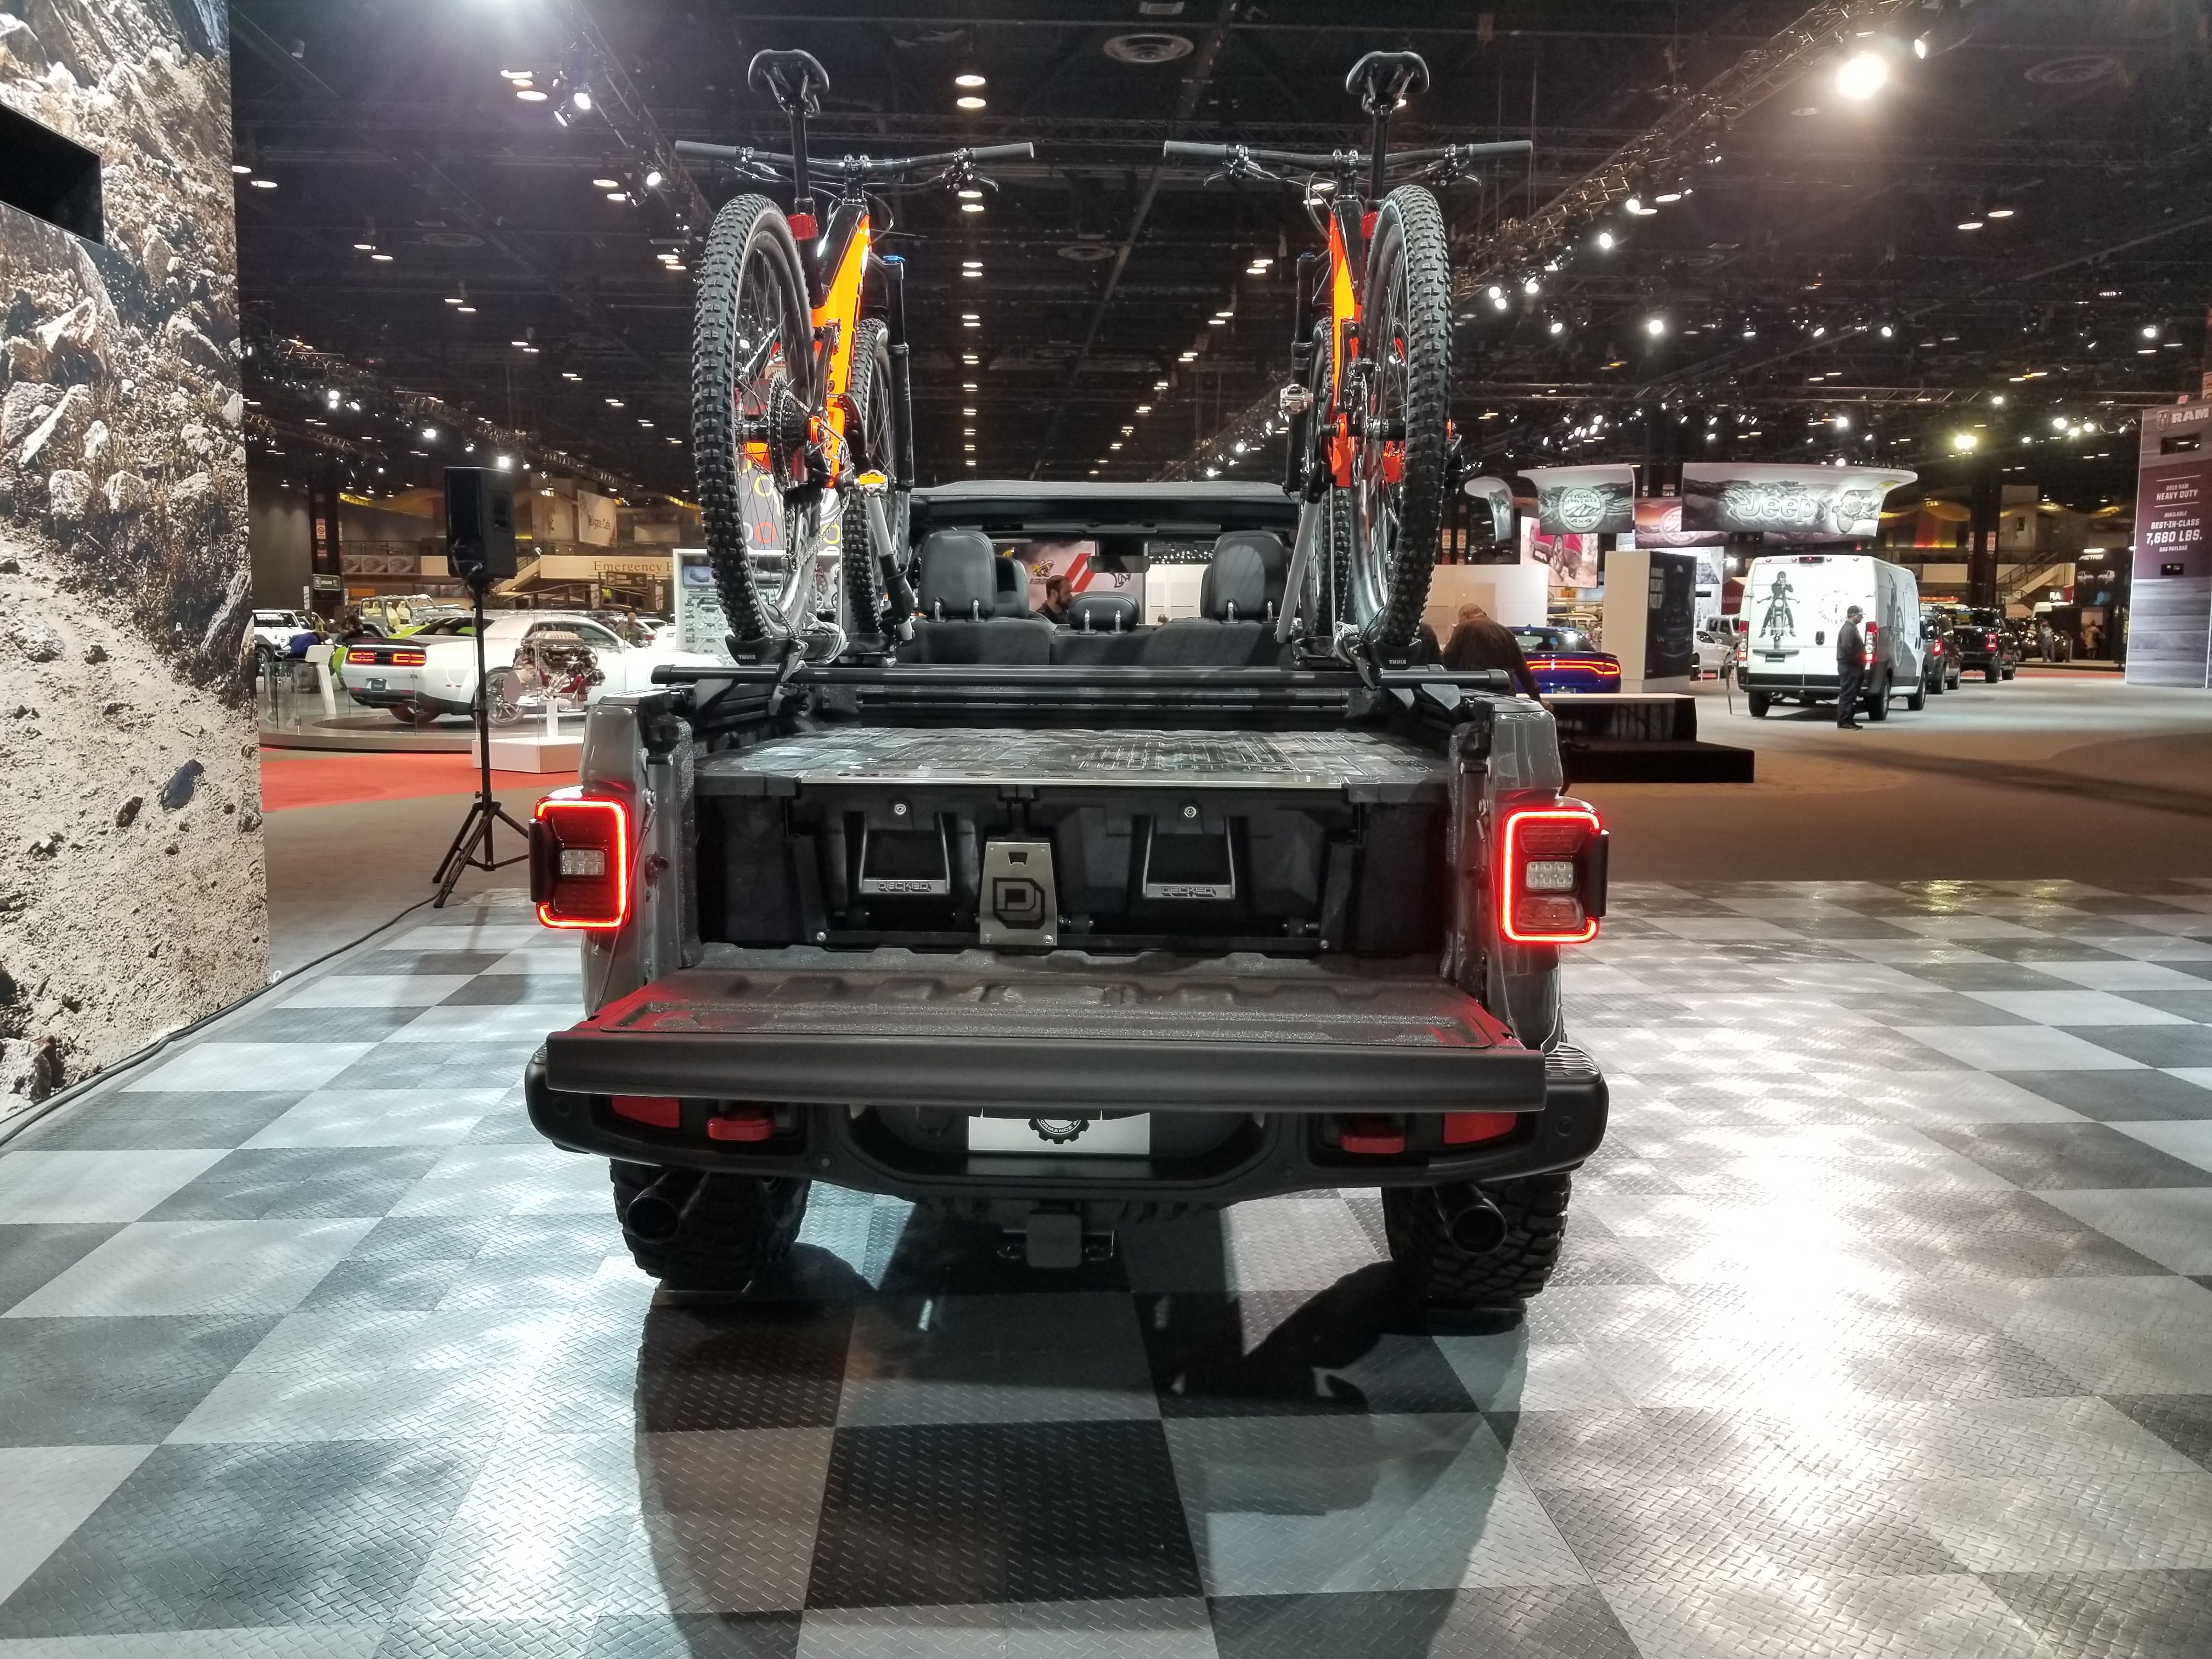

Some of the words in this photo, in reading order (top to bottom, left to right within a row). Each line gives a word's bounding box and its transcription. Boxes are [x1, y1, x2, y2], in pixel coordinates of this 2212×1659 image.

[2171, 408, 2209, 424] RAM
[2157, 492, 2178, 501] HEAVY
[2180, 489, 2198, 498] DUTY
[1737, 492, 1817, 522] Jeep
[2151, 518, 2200, 529] BEST-IN-CLASS
[2146, 531, 2176, 546] 7,680
[2179, 529, 2202, 542] LBS.
[594, 561, 662, 574] Emergency
[878, 881, 932, 892] DECKED
[1161, 886, 1216, 898] DECKED
[1040, 1120, 1073, 1133] ORMANCE
